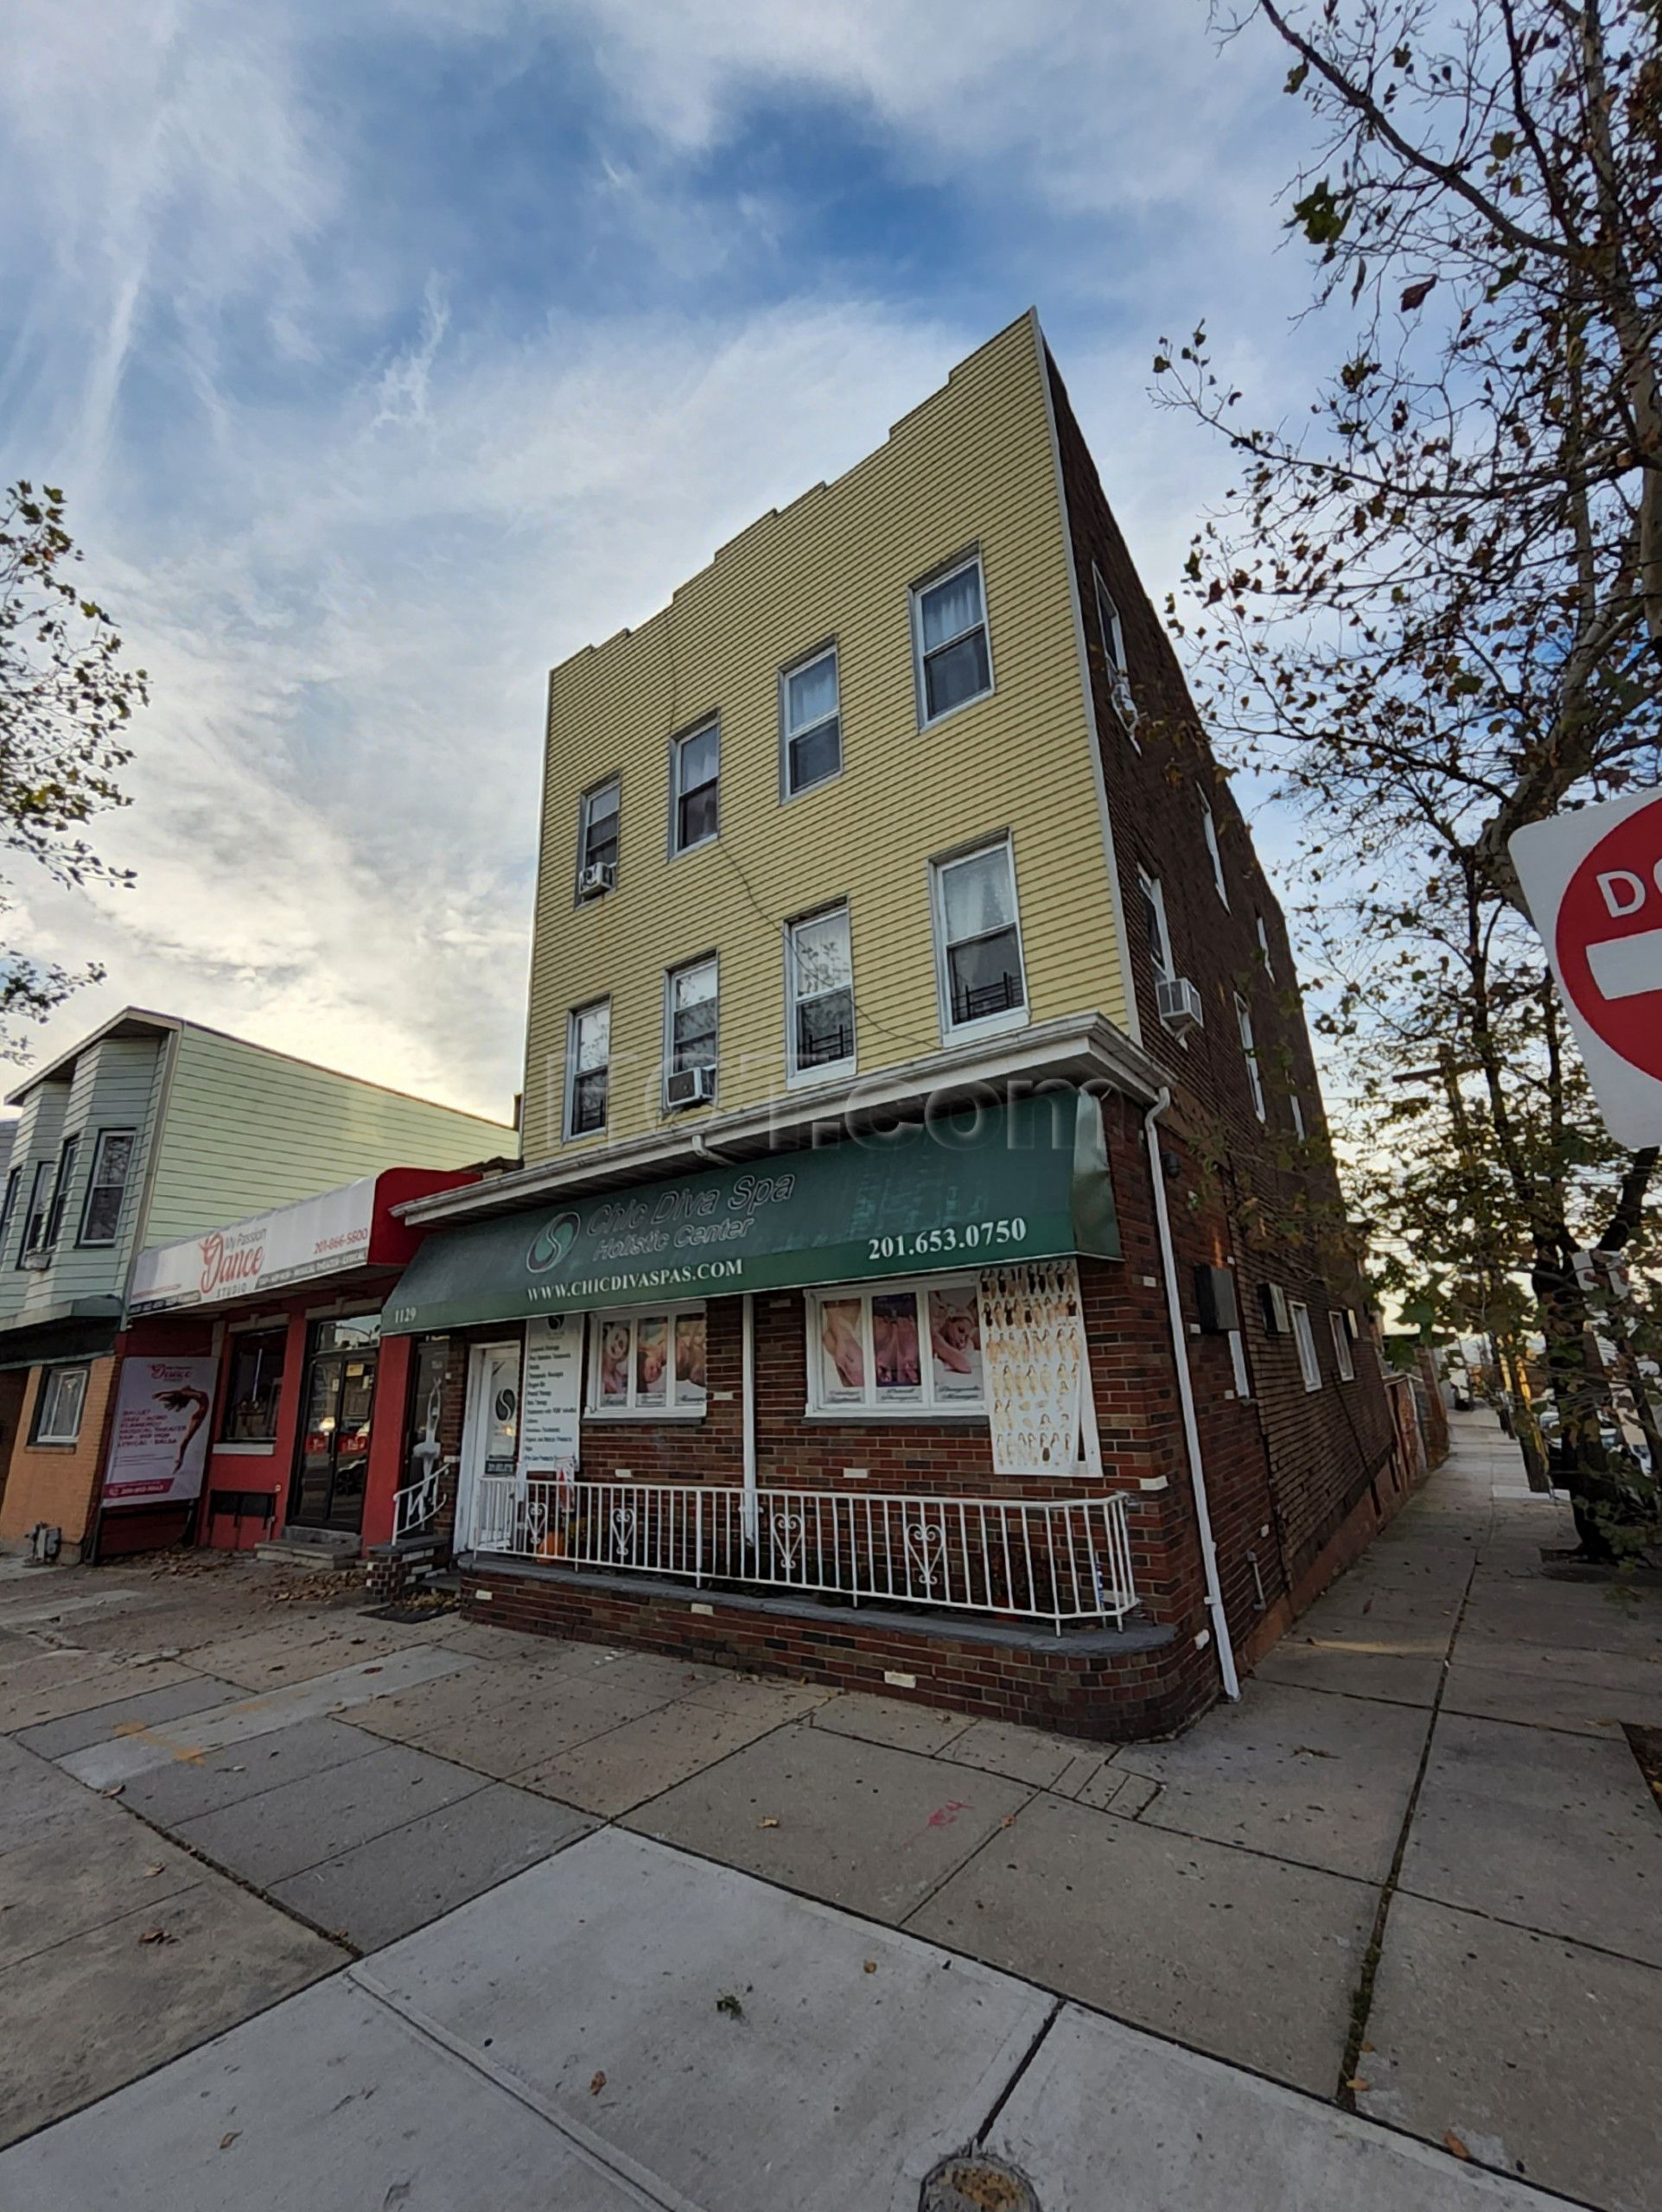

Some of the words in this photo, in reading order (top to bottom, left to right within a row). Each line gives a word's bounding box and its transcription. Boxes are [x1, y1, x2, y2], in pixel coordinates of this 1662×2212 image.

[587, 1198, 648, 1237] Chic
[651, 1188, 721, 1226] Diva
[728, 1174, 795, 1216] Spa
[238, 1228, 267, 1246] Passion
[592, 1228, 671, 1262] Holistic
[672, 1217, 755, 1249] Center
[868, 1217, 1028, 1261] 201.653.0750
[198, 1231, 264, 1294] Dance
[527, 1258, 742, 1301] WWW.CHICDIVASPAS.COM
[394, 1306, 417, 1324] 1129
